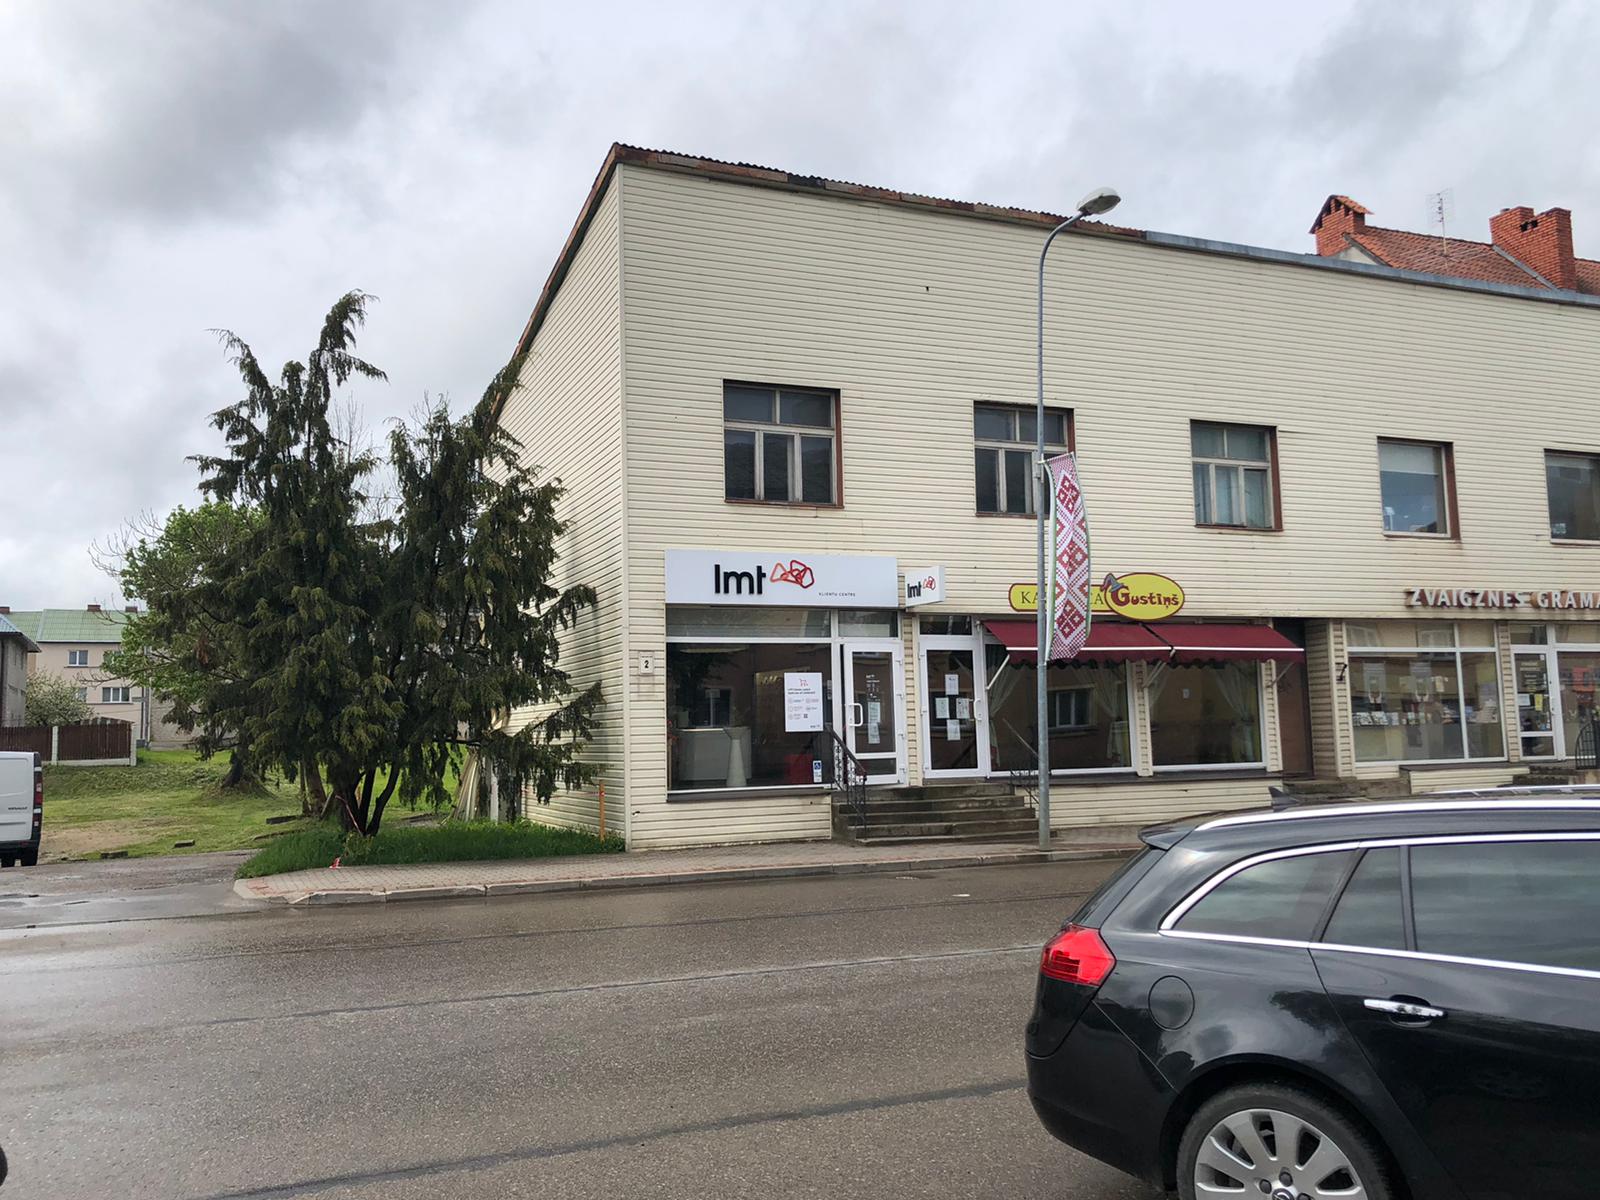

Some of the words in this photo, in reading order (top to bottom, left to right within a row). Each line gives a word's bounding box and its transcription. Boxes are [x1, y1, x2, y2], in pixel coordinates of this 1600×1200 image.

[714, 564, 767, 594] lmt
[907, 581, 921, 598] lmt
[644, 659, 649, 669] 2
